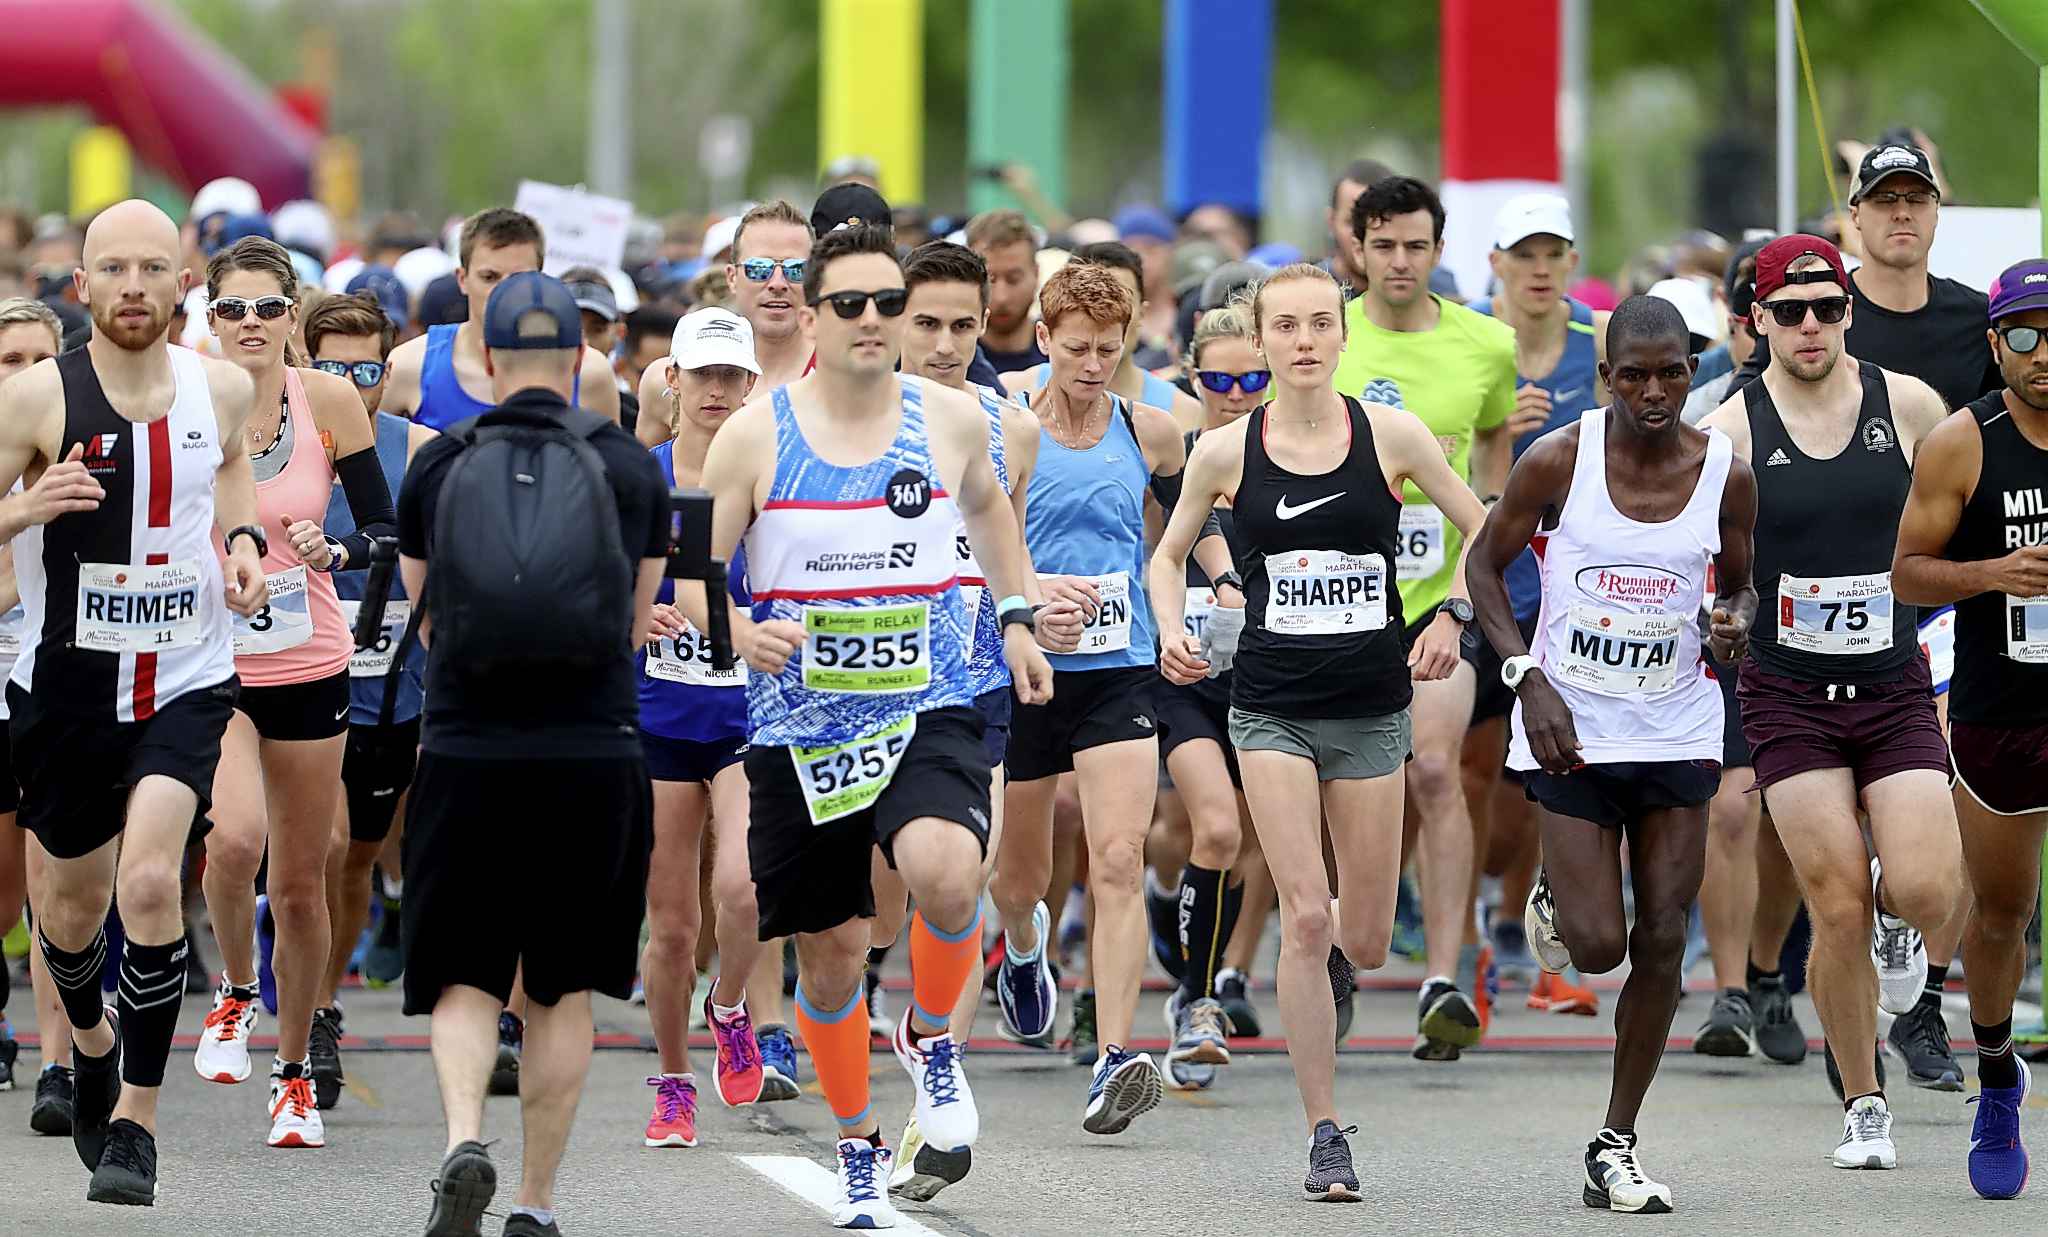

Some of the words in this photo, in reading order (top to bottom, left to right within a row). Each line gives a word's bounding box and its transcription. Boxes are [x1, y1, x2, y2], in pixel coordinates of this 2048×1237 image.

[1766, 458, 1791, 467] adidas
[820, 553, 848, 562] CITY
[851, 551, 885, 561] PARK
[1340, 555, 1364, 565] FULL
[805, 560, 885, 572] Runners
[1325, 563, 1380, 572] MARATHON
[162, 568, 184, 579] FULL
[145, 575, 197, 590] MARATHON
[267, 576, 287, 589] FULL
[1608, 574, 1668, 594] Running
[1852, 579, 1875, 589] FULL
[1275, 575, 1380, 607] SHARPE
[1837, 585, 1888, 598] MARATHON
[1606, 593, 1643, 603] ATHLETIC
[1644, 596, 1664, 604] CLUB
[86, 590, 195, 623] REIMER
[873, 612, 920, 629] RELAY
[1344, 612, 1353, 625] 2
[1819, 601, 1869, 631] 75
[1645, 621, 1668, 629] FULL
[154, 629, 174, 644] 11
[1628, 627, 1678, 638] MARATHON
[1091, 635, 1107, 647] 10
[1846, 637, 1870, 646] JOHN
[673, 631, 741, 664] 65
[814, 631, 920, 669] 5255
[1570, 629, 1675, 668] MUTAI
[704, 669, 738, 679] NICOLE
[866, 675, 903, 686] RUNNER
[1637, 675, 1646, 687] 7
